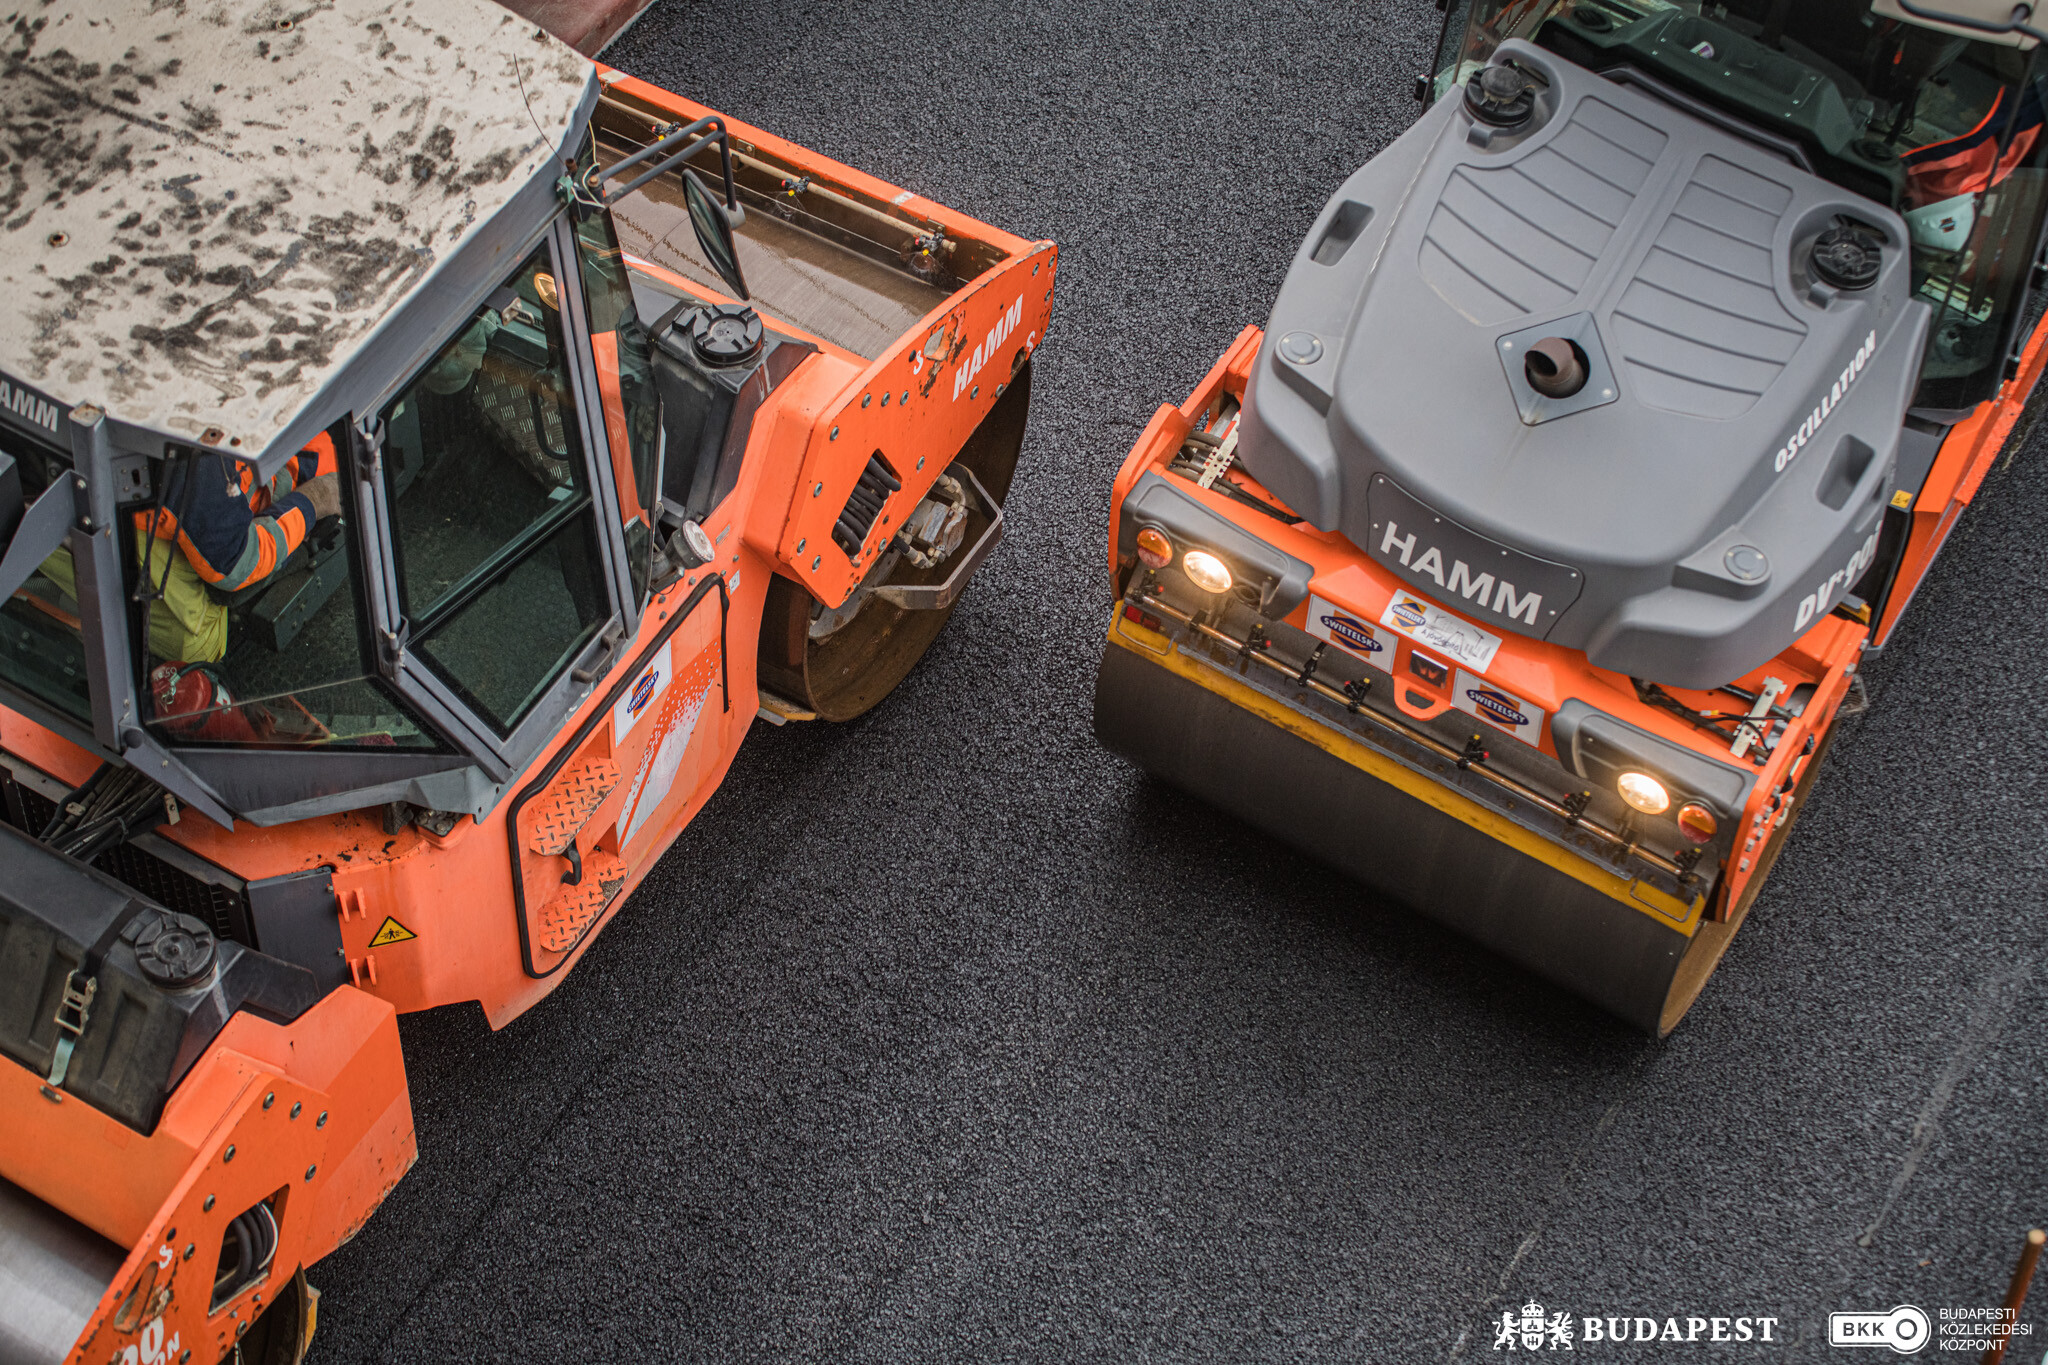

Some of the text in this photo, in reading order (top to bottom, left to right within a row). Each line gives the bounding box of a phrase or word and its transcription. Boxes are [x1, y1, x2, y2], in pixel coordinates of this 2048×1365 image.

[953, 293, 1023, 402] HAMM
[1775, 329, 1876, 473] OSCILLATION
[1380, 521, 1543, 625] HAMM
[1324, 617, 1380, 650] SWIETELSKY
[1393, 605, 1425, 625] SWIETELSKY
[628, 671, 659, 712] SWIETELSKY
[1469, 691, 1525, 723] SWIETELSKY
